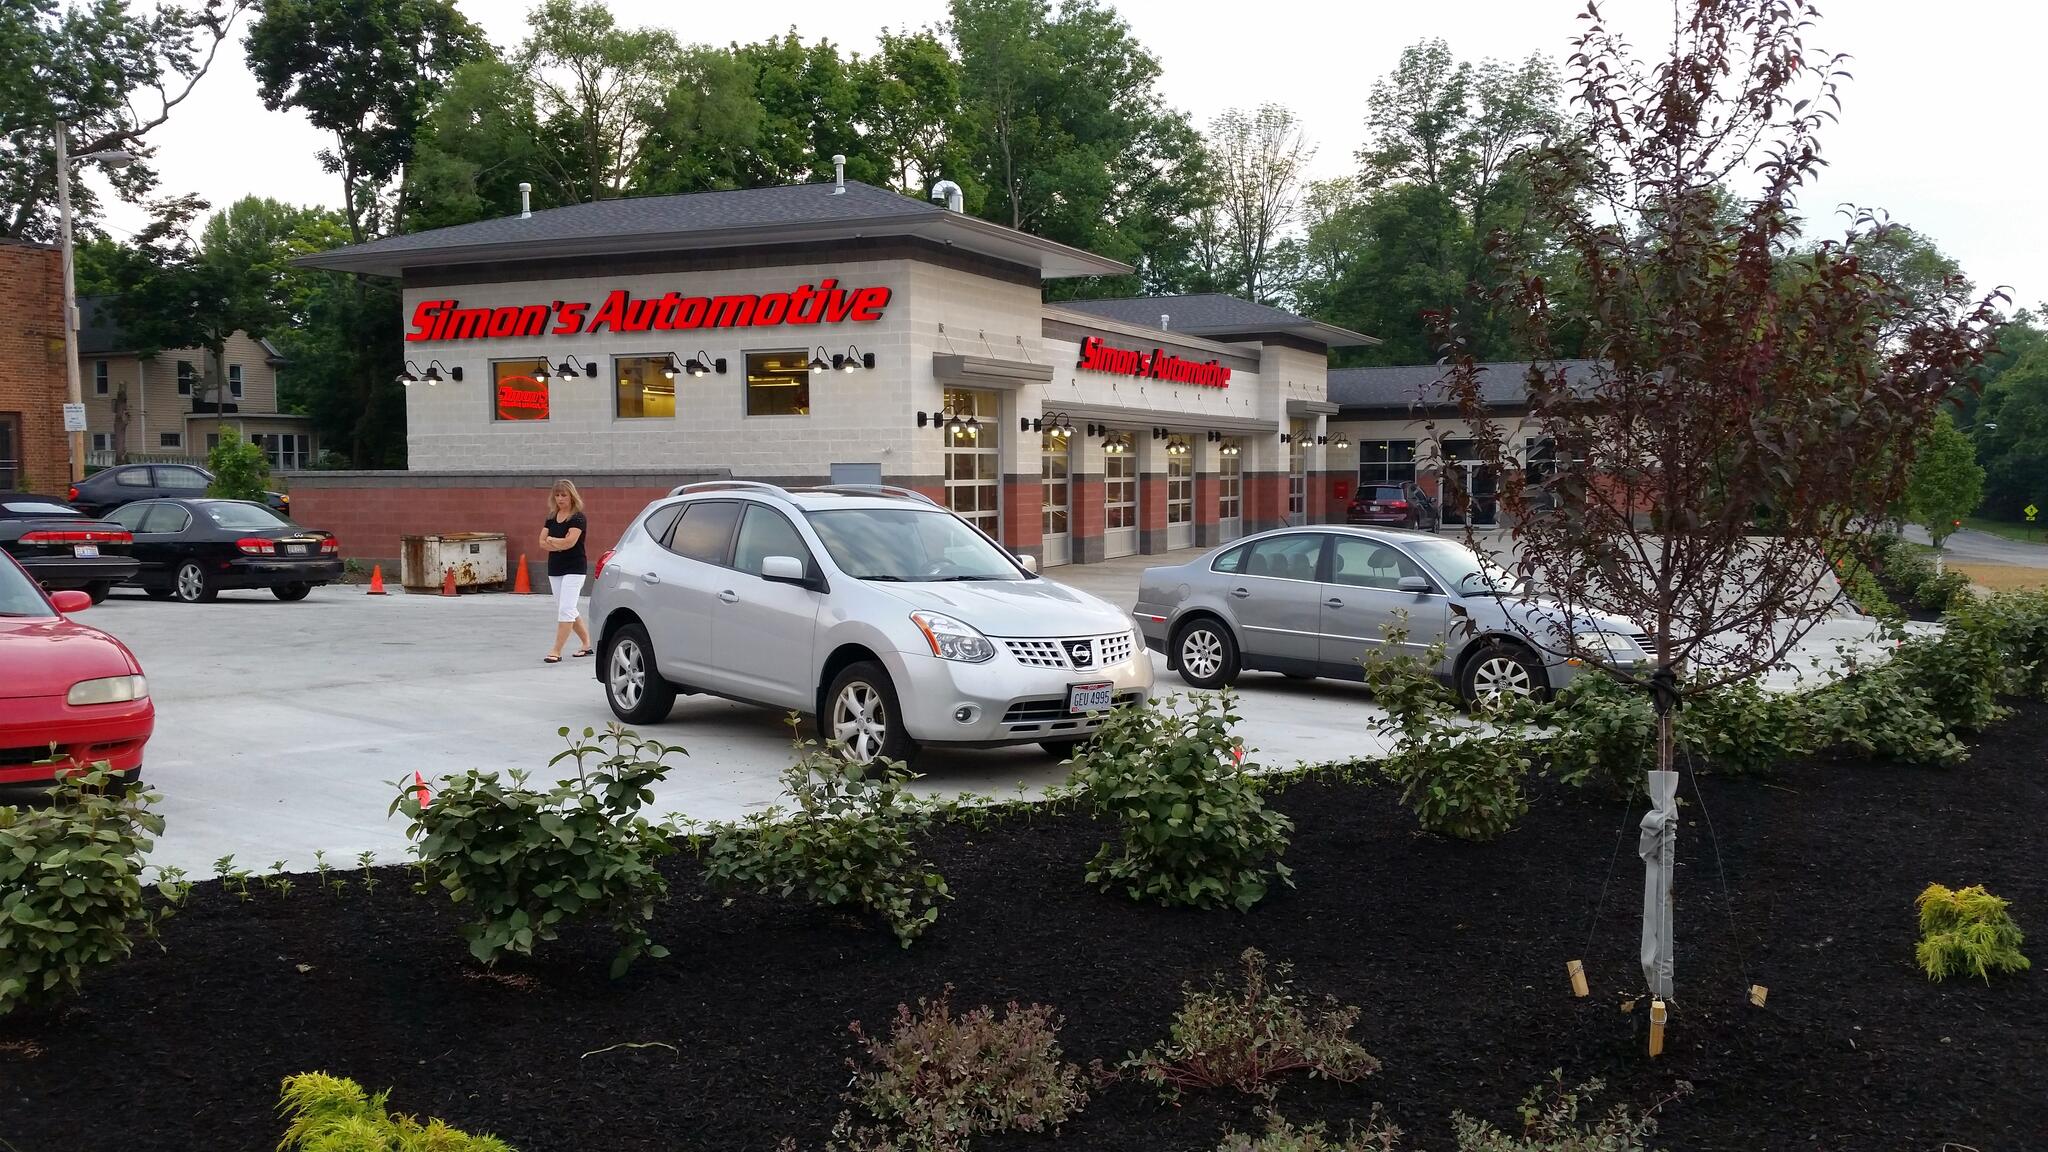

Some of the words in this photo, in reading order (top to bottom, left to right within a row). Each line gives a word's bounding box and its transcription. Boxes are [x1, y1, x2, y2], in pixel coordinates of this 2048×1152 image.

[405, 300, 587, 341] Simon's
[586, 279, 892, 333] Automotive
[1077, 336, 1151, 377] Simon's
[1151, 348, 1231, 388] Automotive
[1074, 693, 1089, 706] GEU
[1090, 691, 1109, 705] 4995
